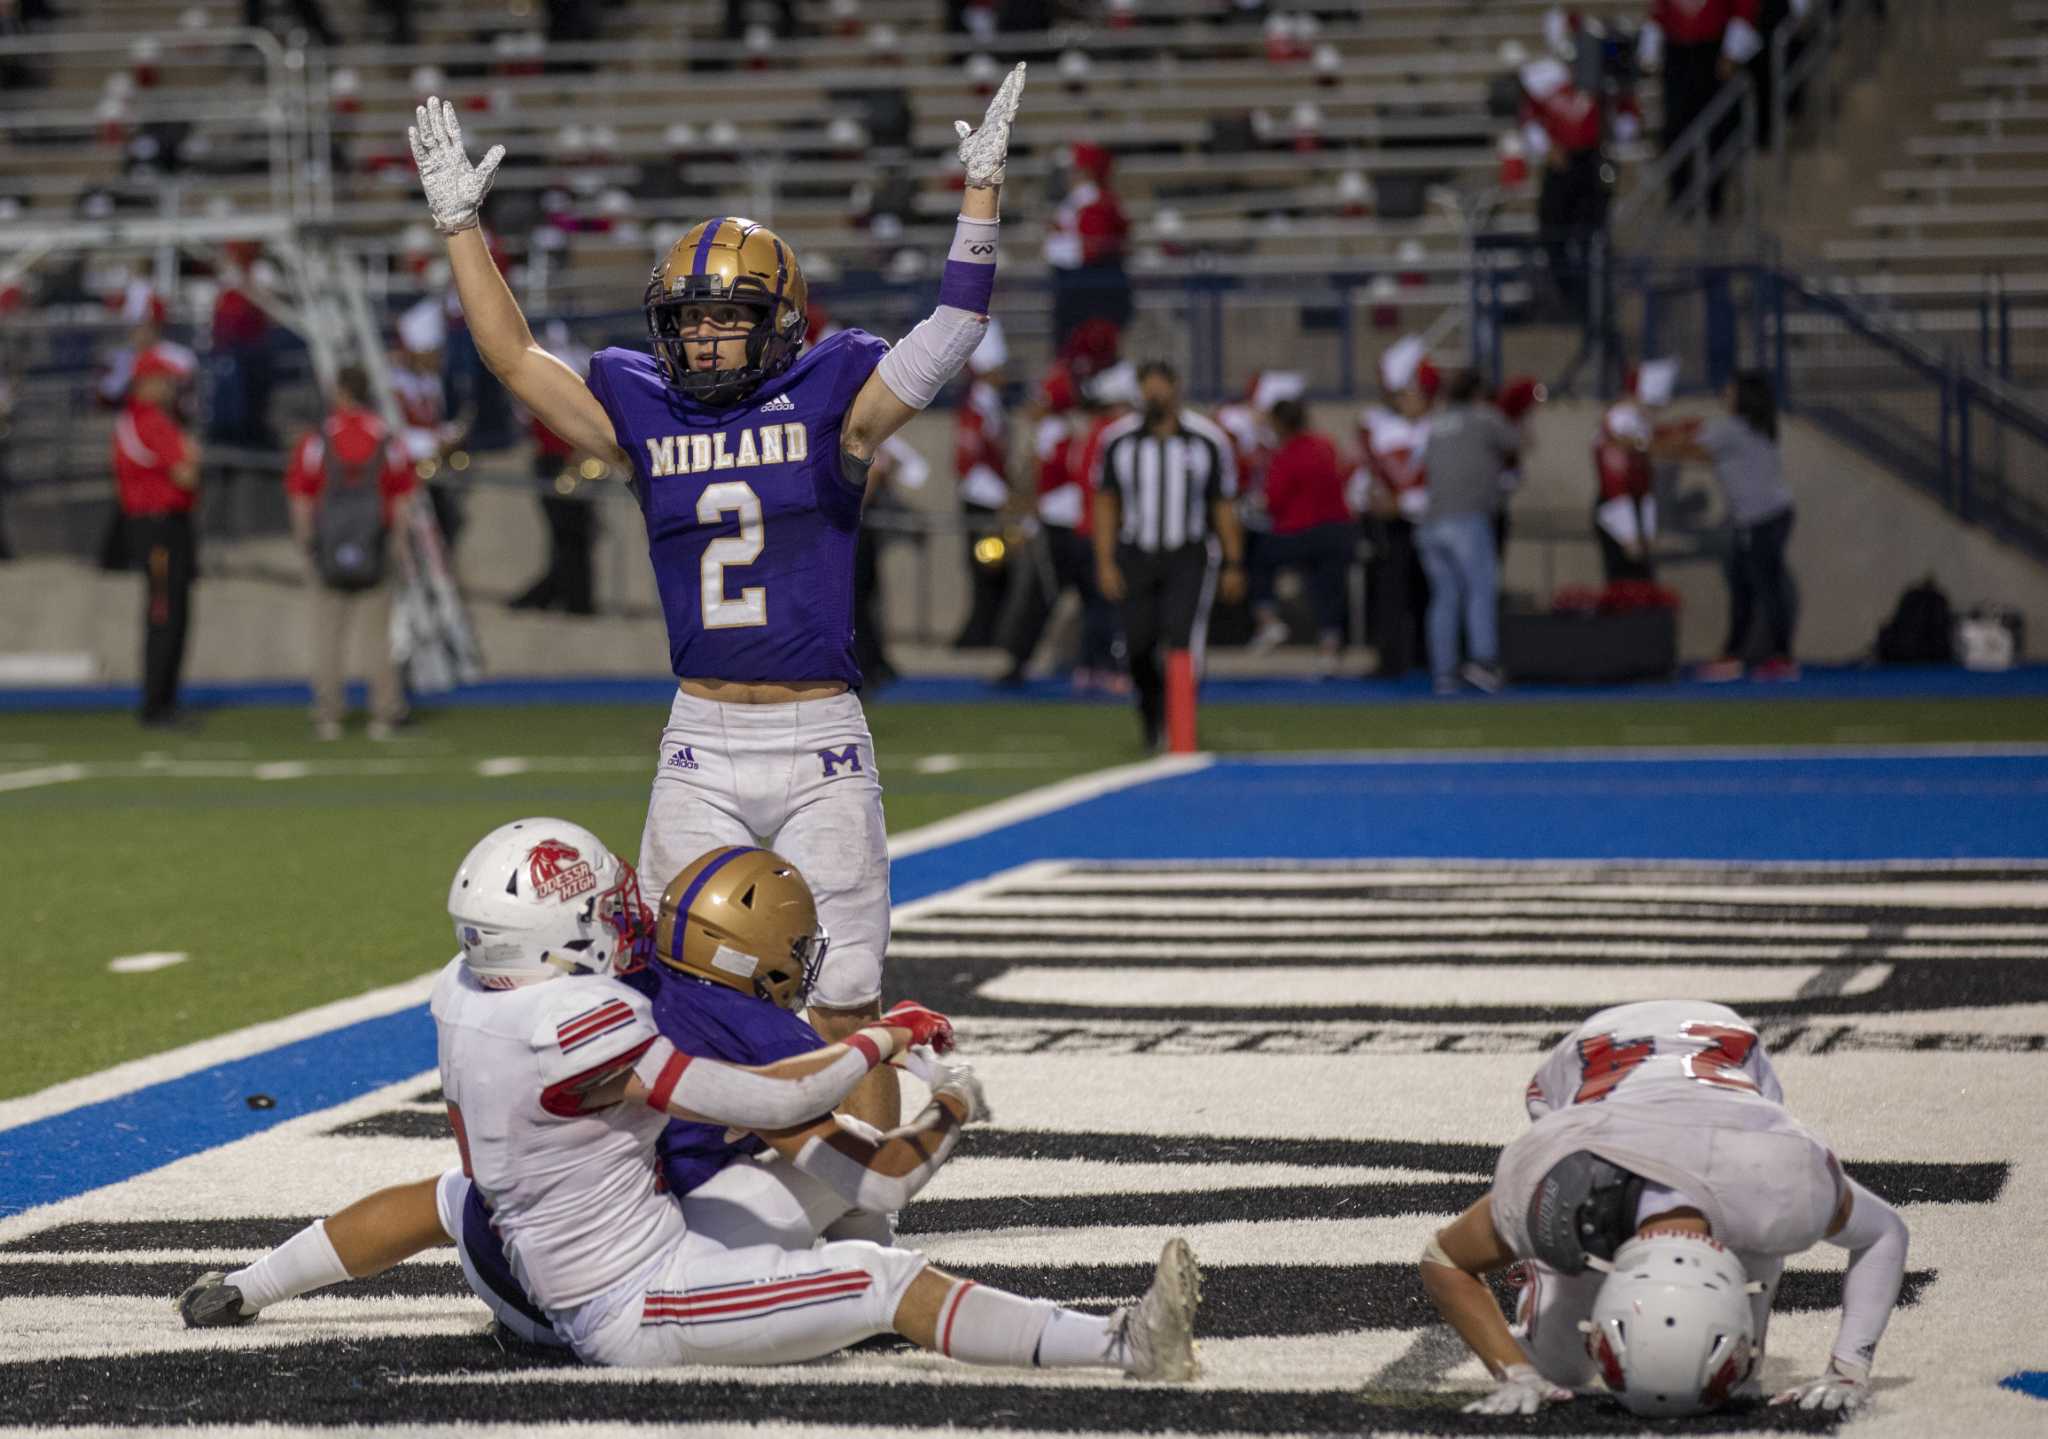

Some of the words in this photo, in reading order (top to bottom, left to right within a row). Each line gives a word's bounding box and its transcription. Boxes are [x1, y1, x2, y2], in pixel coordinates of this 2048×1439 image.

[760, 402, 795, 413] adidas
[646, 422, 808, 477] MIDLAND
[696, 481, 767, 629] 2
[667, 758, 699, 770] adidas
[817, 744, 863, 777] M
[537, 861, 590, 897] ODESSA
[561, 875, 595, 900] HIGH
